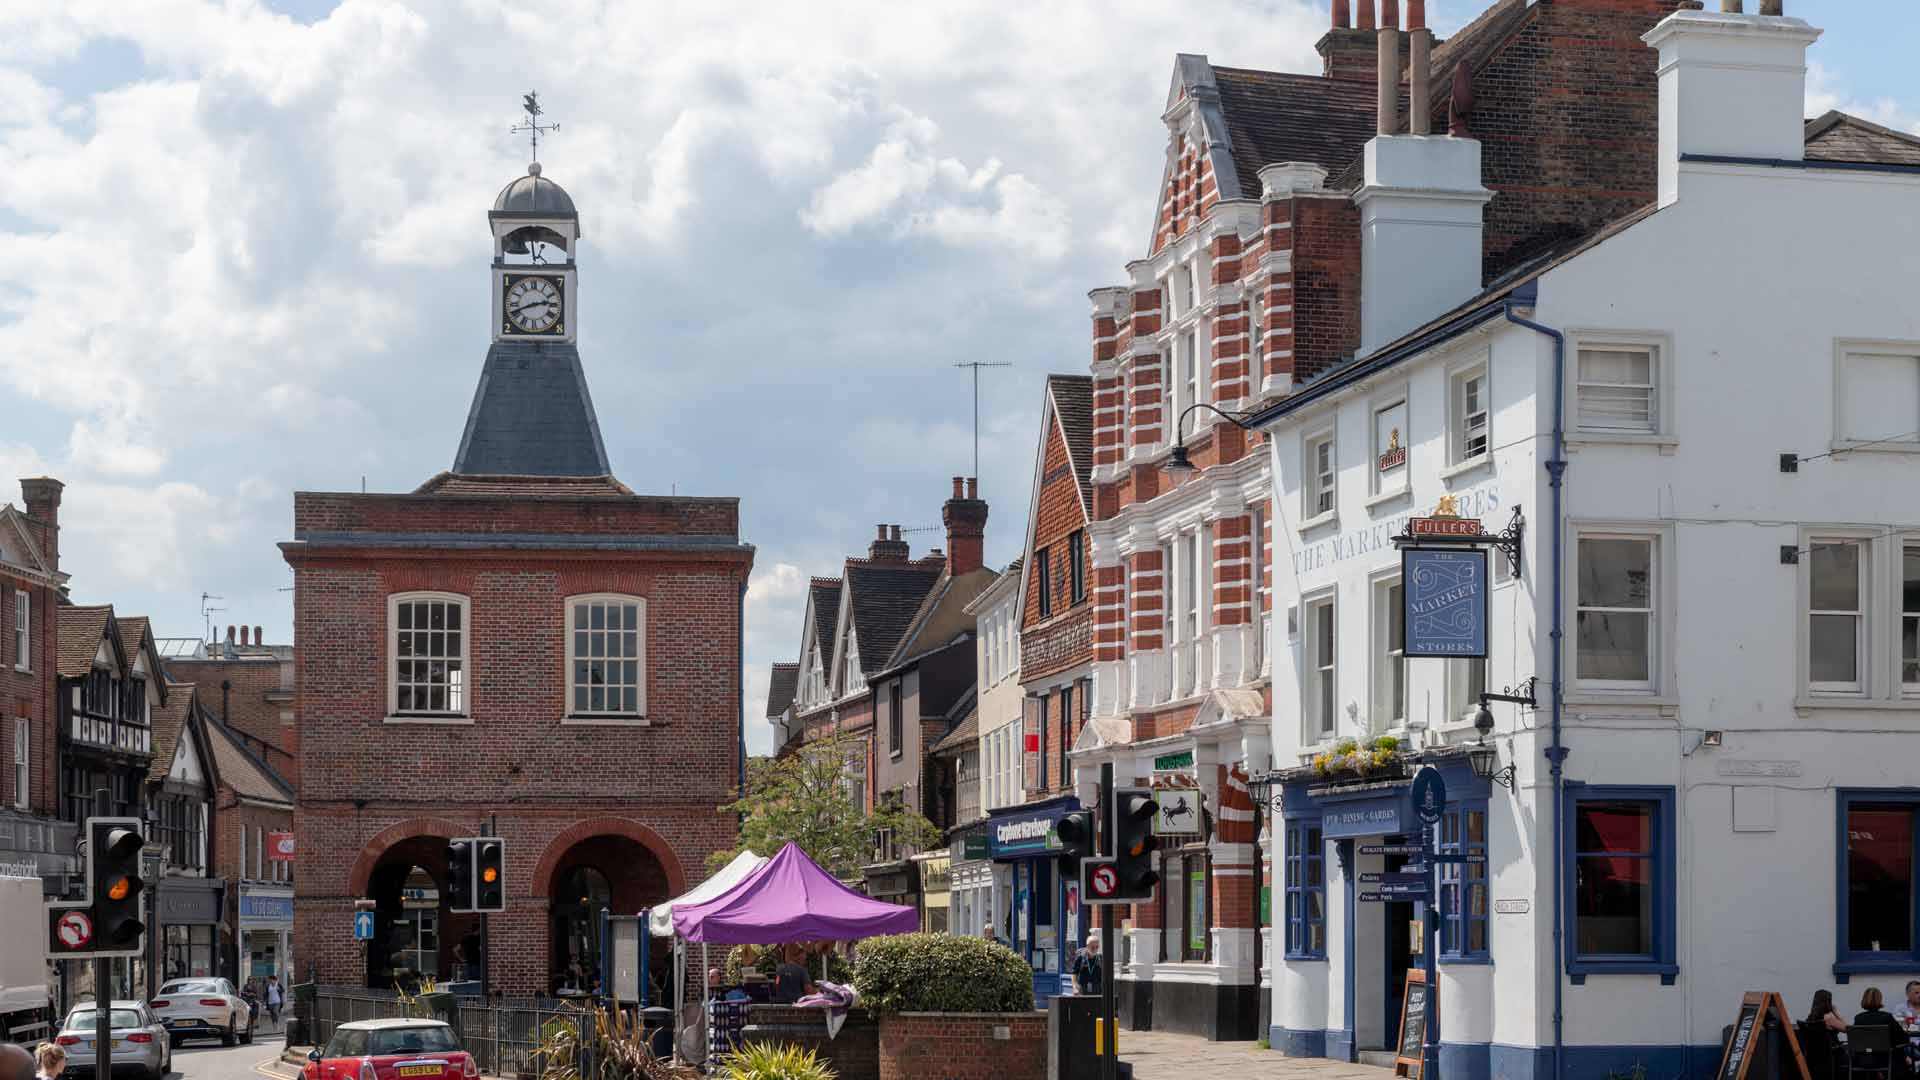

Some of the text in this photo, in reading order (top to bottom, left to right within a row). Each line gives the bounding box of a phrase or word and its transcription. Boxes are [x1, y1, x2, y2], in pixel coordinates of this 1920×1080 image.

[504, 276, 564, 288] 1 7
[504, 322, 564, 334] 2 8
[1292, 544, 1324, 575] THE
[1332, 516, 1408, 563] MARKET
[1410, 583, 1478, 615] MARKET
[1416, 642, 1475, 652] STORES
